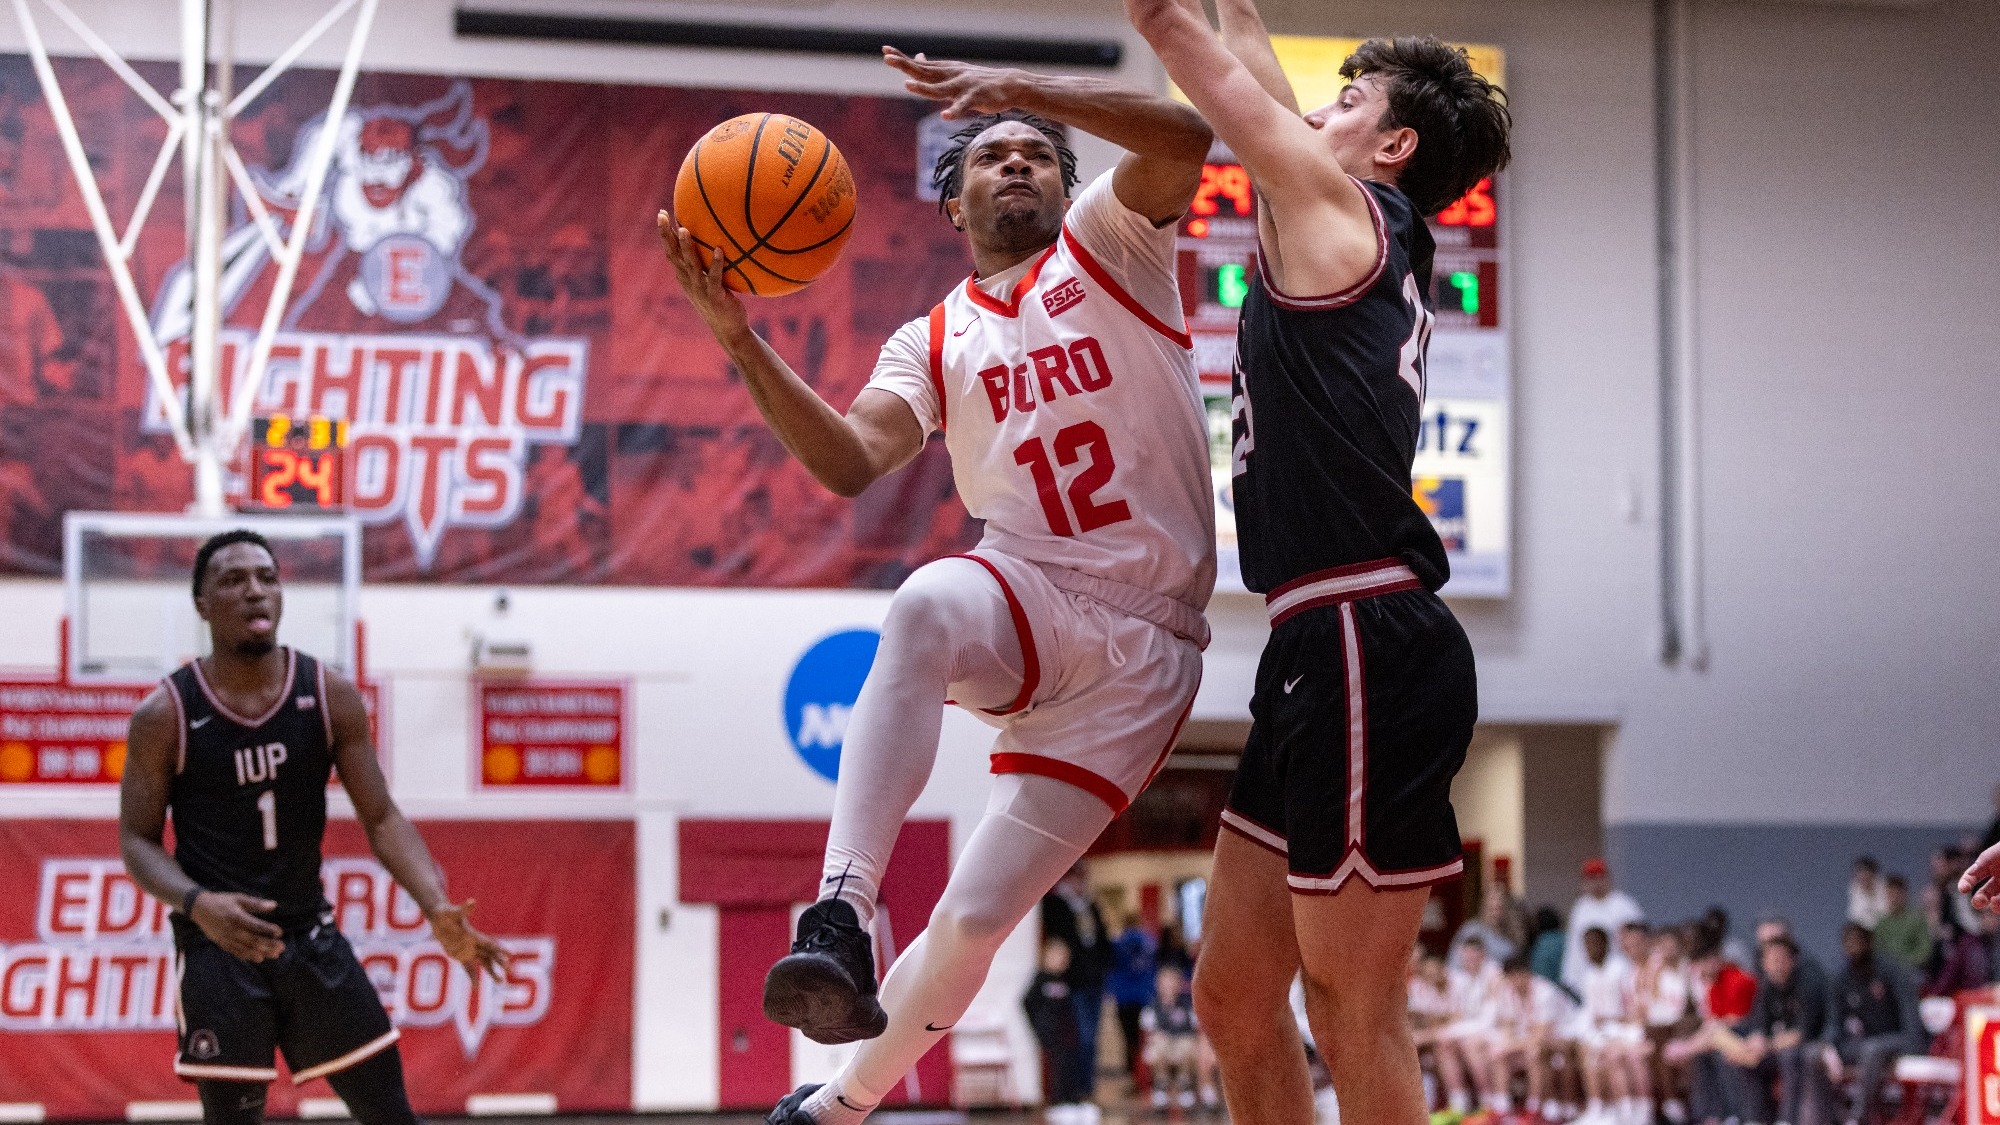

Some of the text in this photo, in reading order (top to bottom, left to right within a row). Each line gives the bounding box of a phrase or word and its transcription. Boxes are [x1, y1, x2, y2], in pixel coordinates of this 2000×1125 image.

[778, 118, 810, 189] EVO NXT
[389, 246, 426, 305] E
[1043, 281, 1084, 312] PSAC
[977, 336, 1113, 423] BORO
[262, 450, 334, 508] 24
[1013, 420, 1132, 537] 12
[235, 743, 287, 785] IUP
[257, 790, 278, 850] 1
